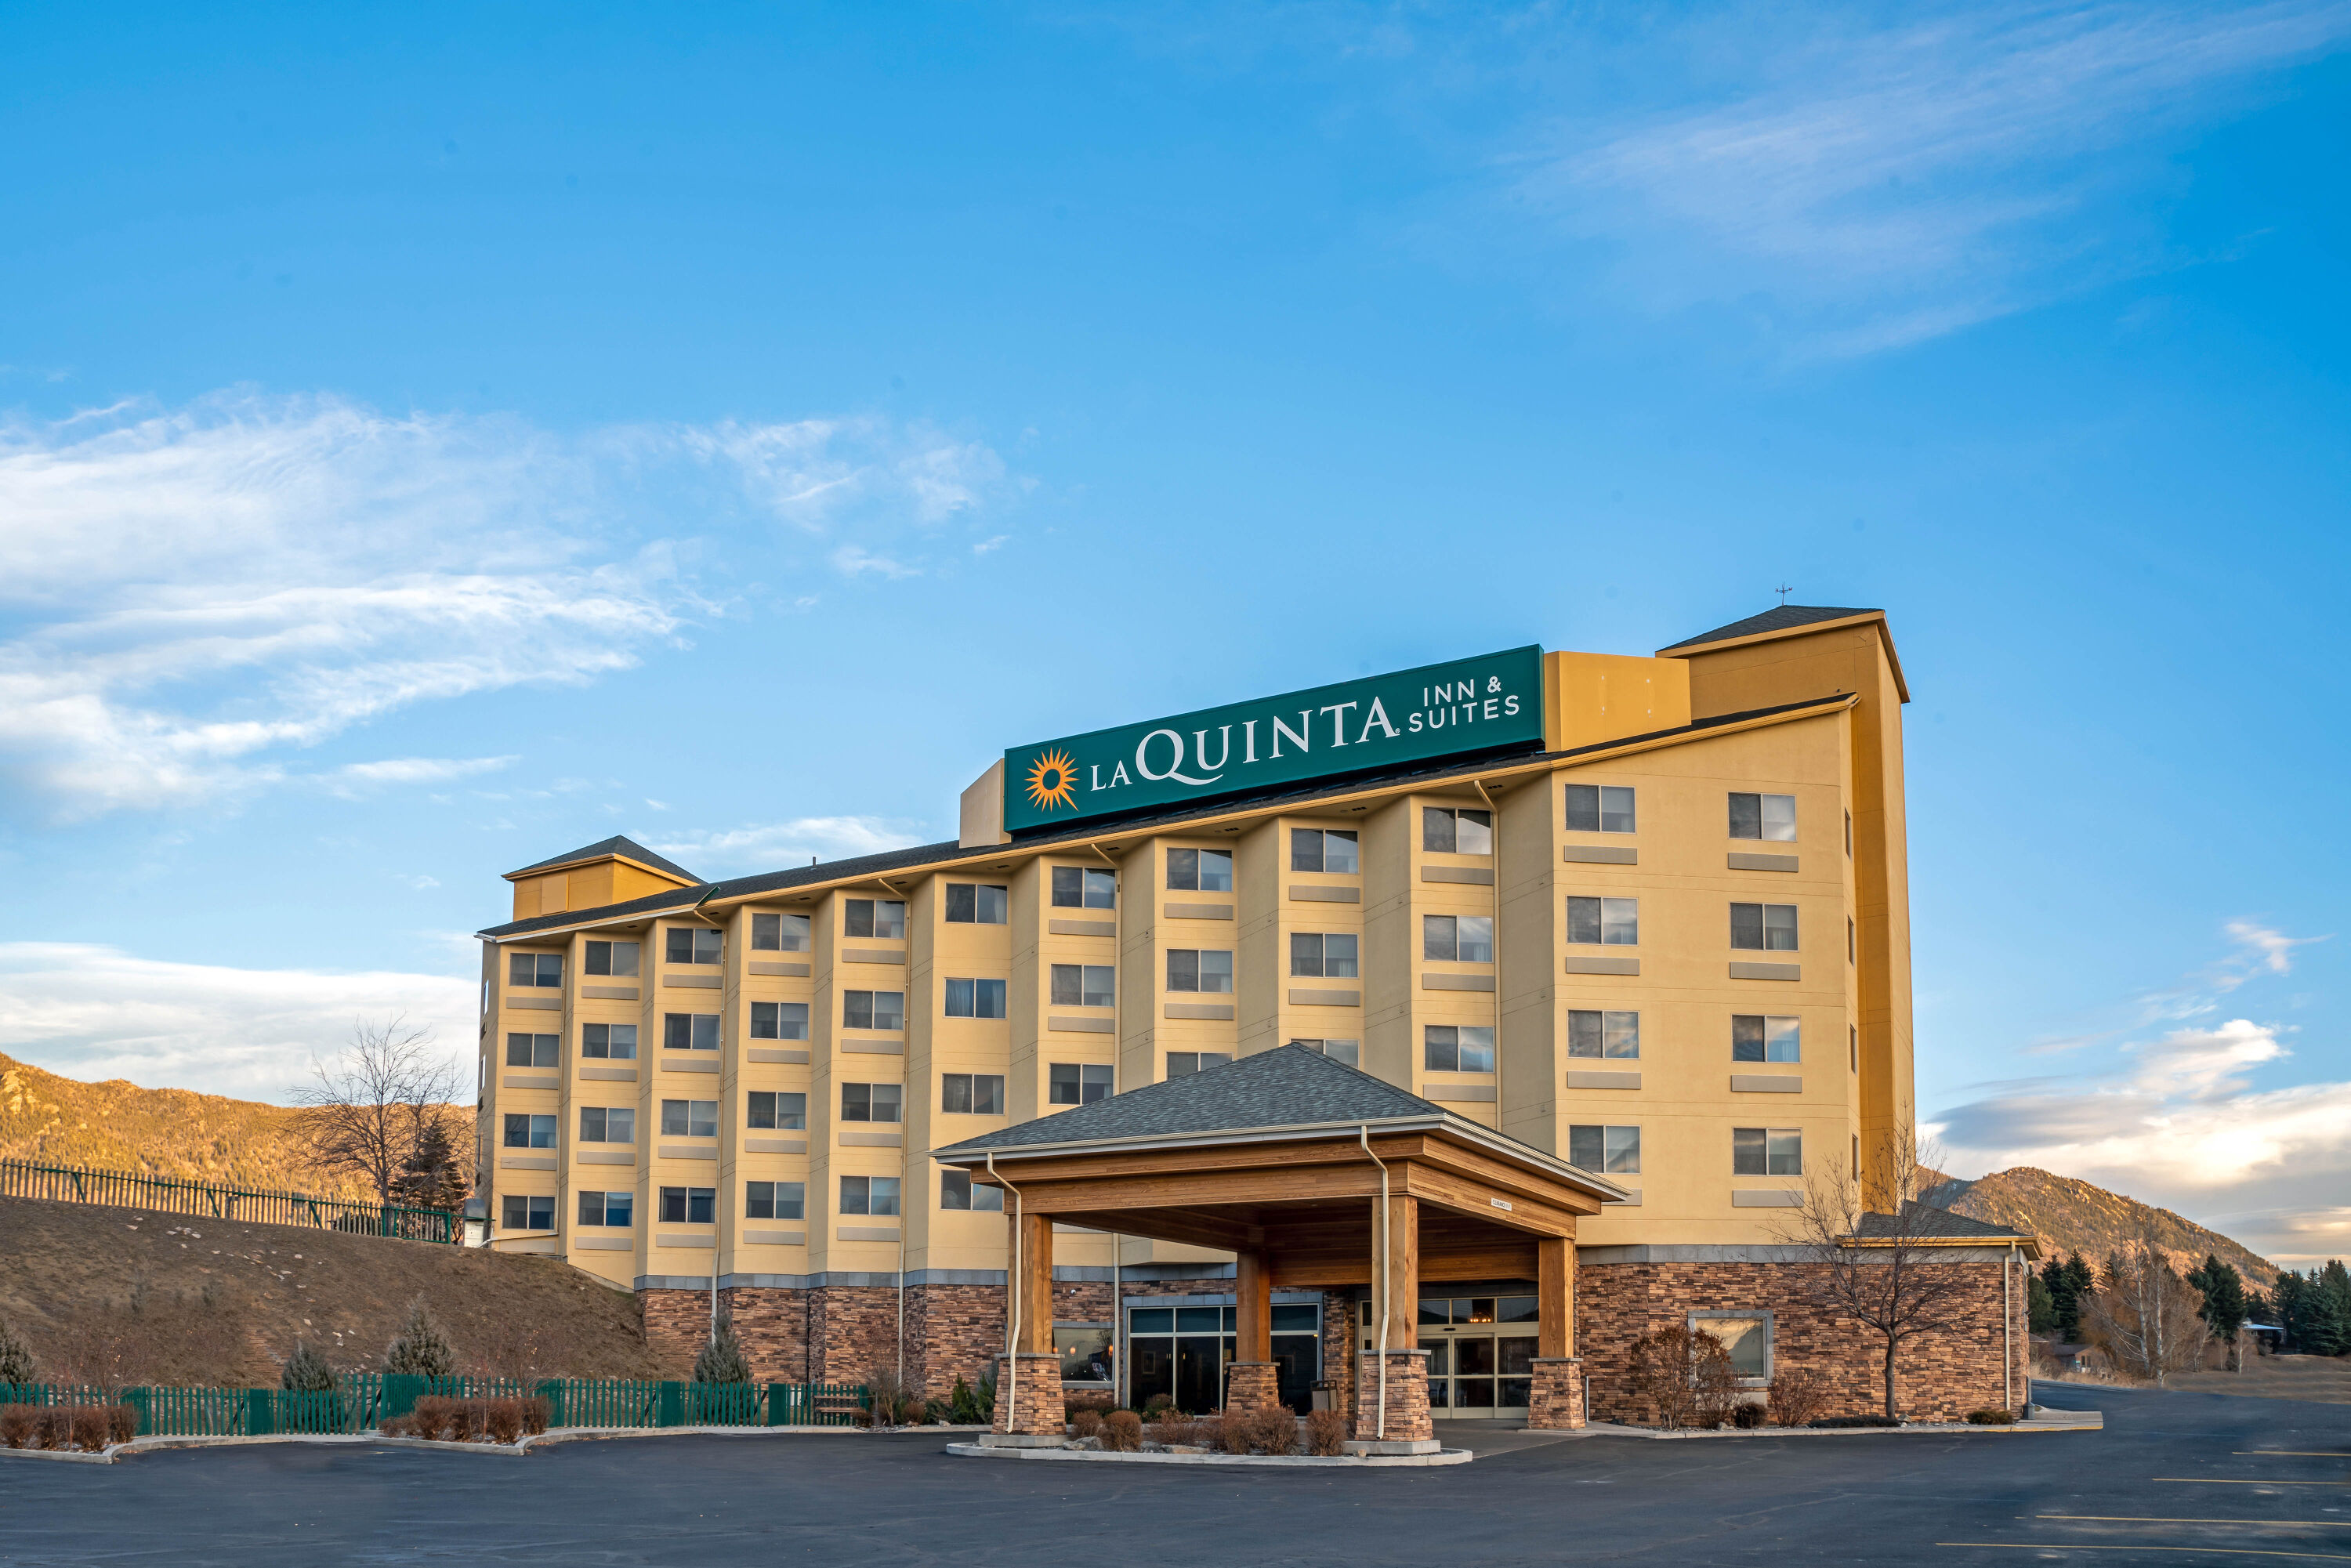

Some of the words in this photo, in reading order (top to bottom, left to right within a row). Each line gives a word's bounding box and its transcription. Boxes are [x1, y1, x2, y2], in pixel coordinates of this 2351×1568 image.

[1424, 679, 1475, 707] INN
[1487, 675, 1502, 693] &
[1408, 694, 1520, 733] SUITES
[1090, 759, 1133, 791] LA
[1136, 696, 1400, 786] QUINTA
